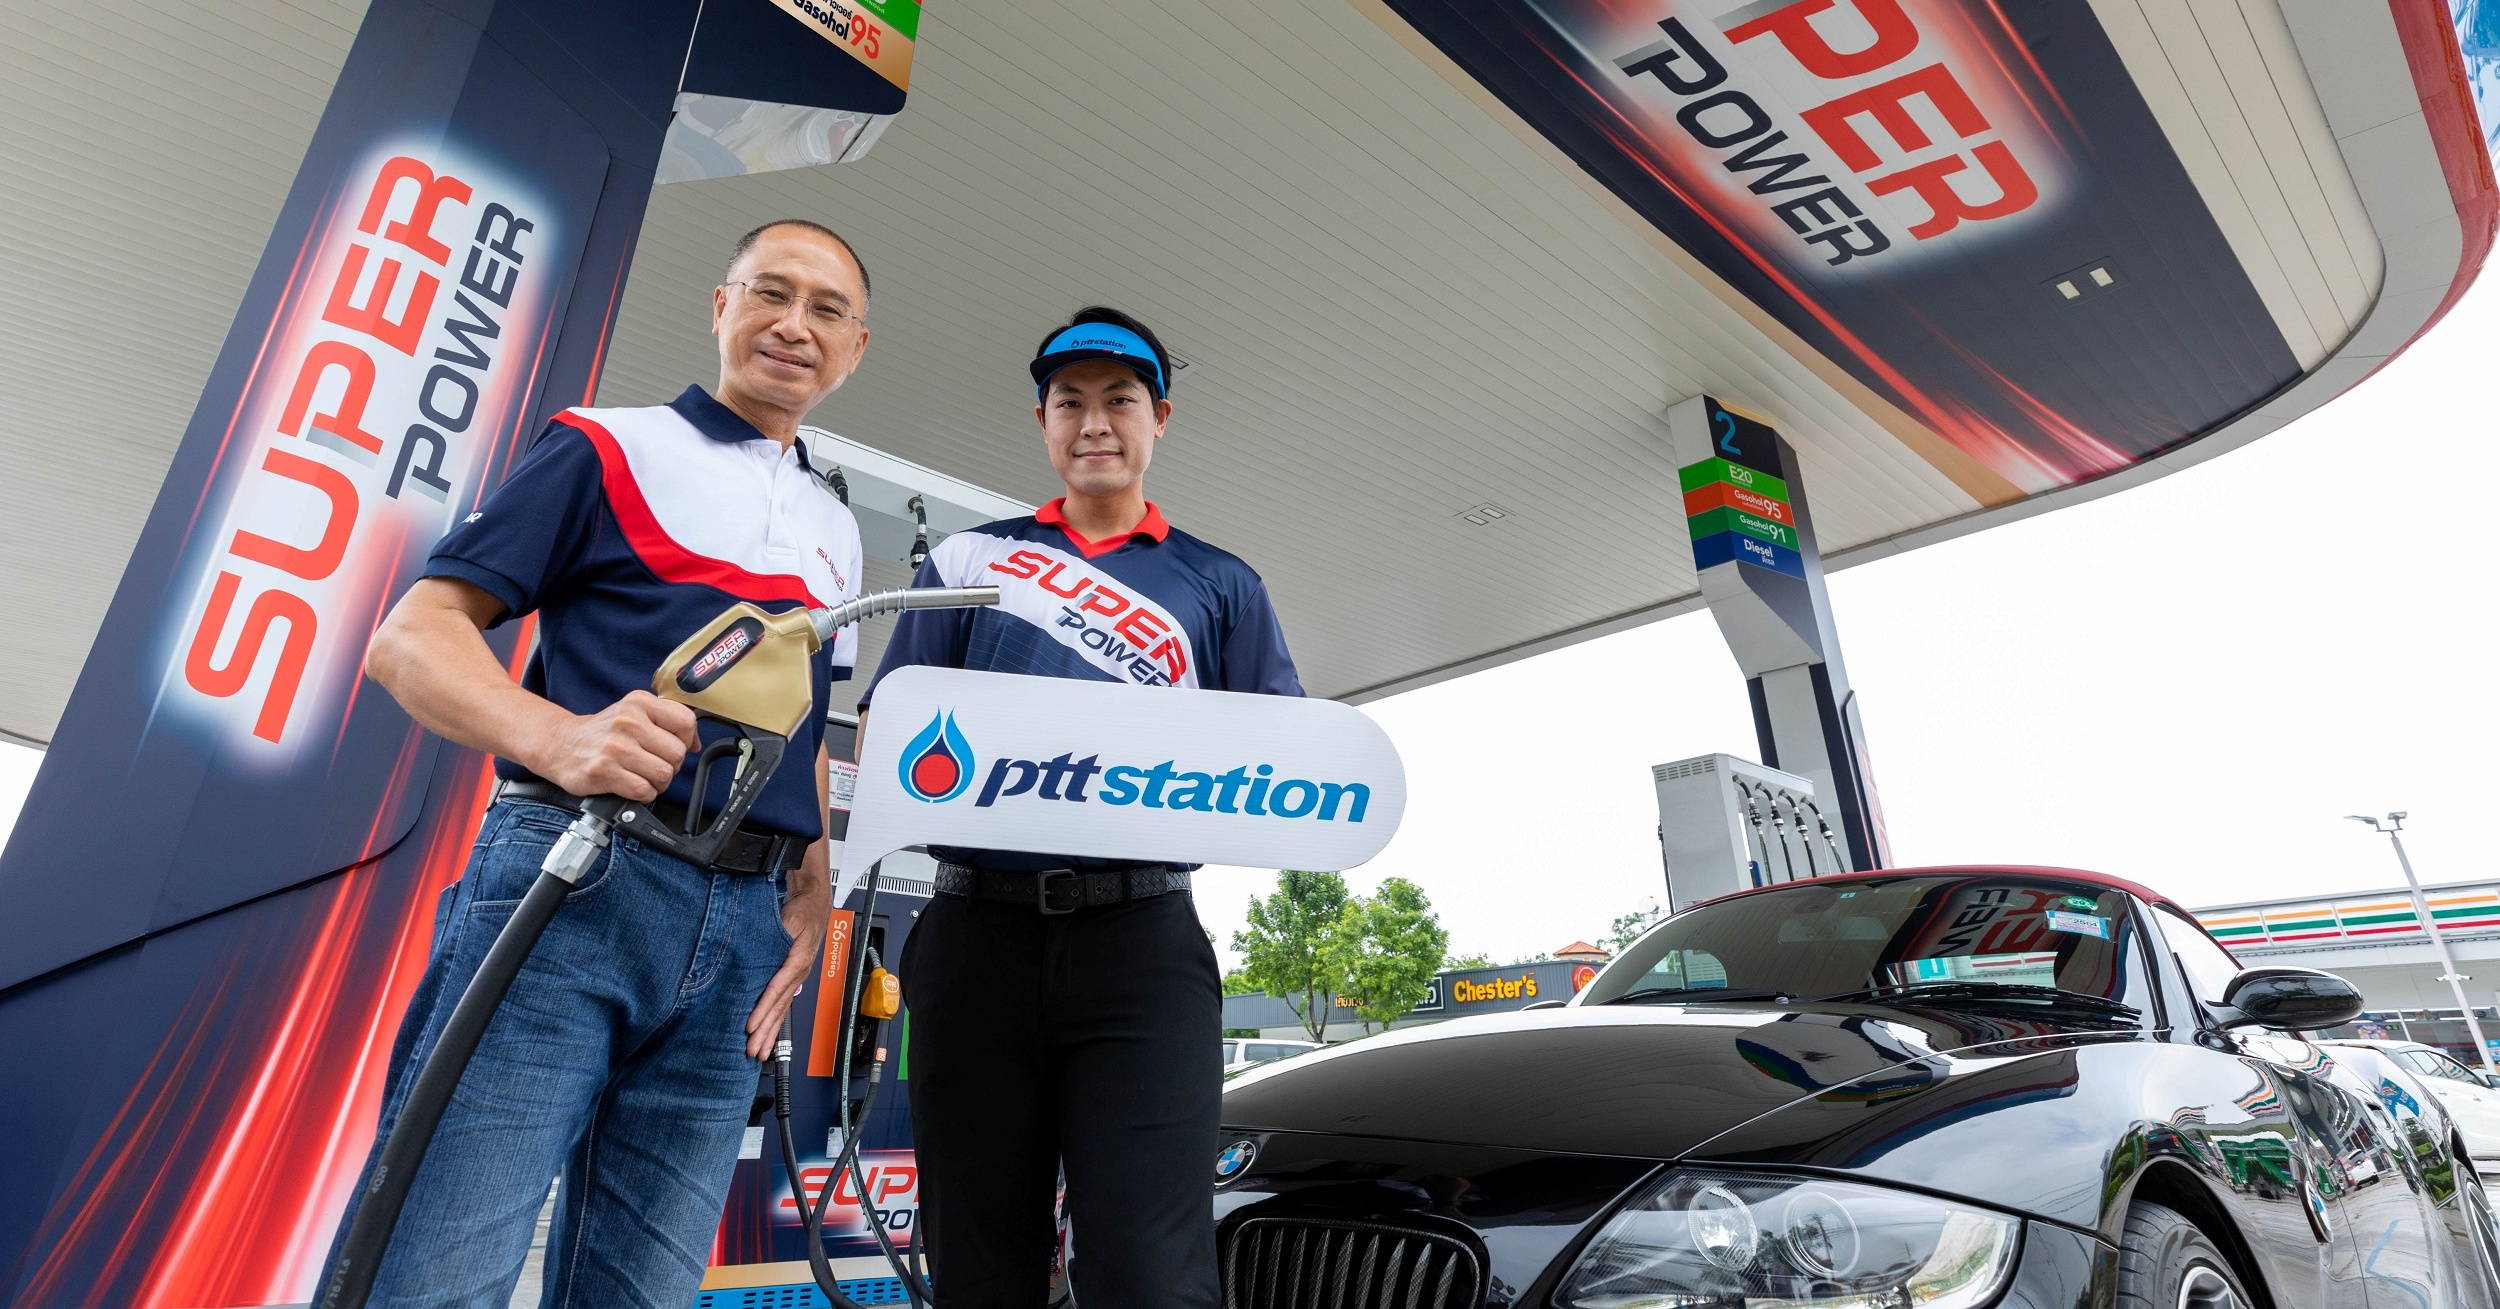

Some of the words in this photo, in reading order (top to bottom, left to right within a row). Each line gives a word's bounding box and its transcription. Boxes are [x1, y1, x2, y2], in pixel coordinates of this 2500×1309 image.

[851, 14, 881, 59] 95
[1613, 17, 1891, 266] POWER
[385, 202, 534, 503] POWER
[185, 156, 473, 744] SUPER
[1715, 410, 1742, 456] 2
[1729, 465, 1753, 484] E20
[1734, 490, 1764, 506] Gasohol
[1763, 500, 1782, 519] 95
[1740, 515, 1769, 531] Gasohol
[1769, 525, 1786, 543] 91
[1744, 539, 1773, 558] Diesel
[988, 550, 1187, 684] SUPER
[694, 629, 745, 677] SUPER
[717, 638, 748, 664] POWER
[832, 919, 848, 941] 95
[827, 941, 839, 977] Gasohol
[1454, 975, 1537, 1003] Chester's
[780, 1167, 918, 1207] SUP
